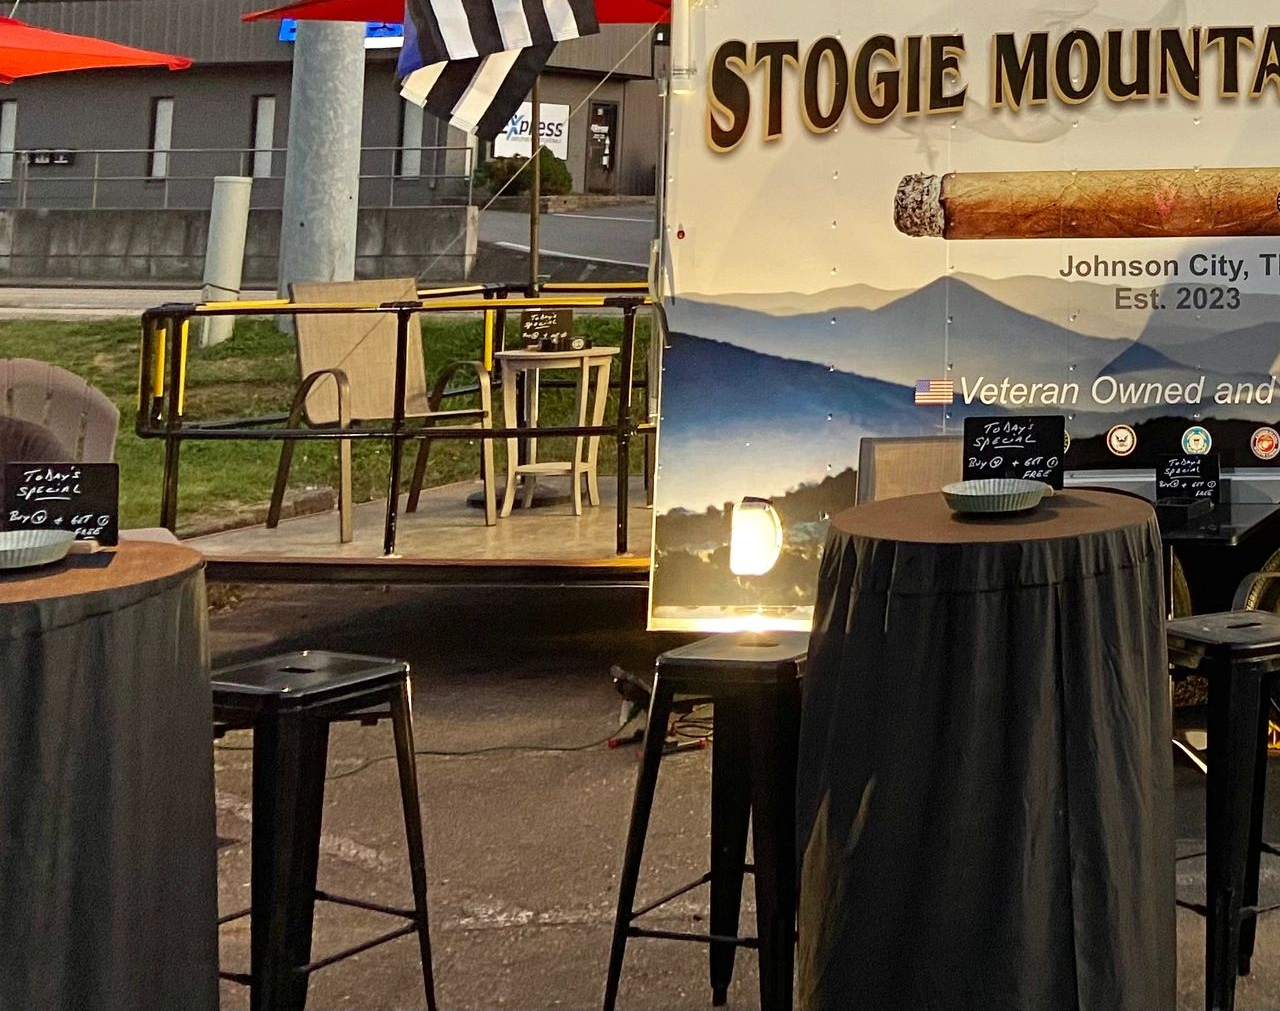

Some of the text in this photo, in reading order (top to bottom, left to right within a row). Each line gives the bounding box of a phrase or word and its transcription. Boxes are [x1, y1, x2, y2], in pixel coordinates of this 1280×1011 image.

[705, 32, 968, 153] STOGIE
[1059, 254, 1178, 277] Johnson
[1189, 254, 1249, 282] City,
[1115, 287, 1241, 310] Est. 2023
[960, 376, 1080, 405] Veteran
[1091, 375, 1206, 405] Owned
[1214, 376, 1277, 405] and
